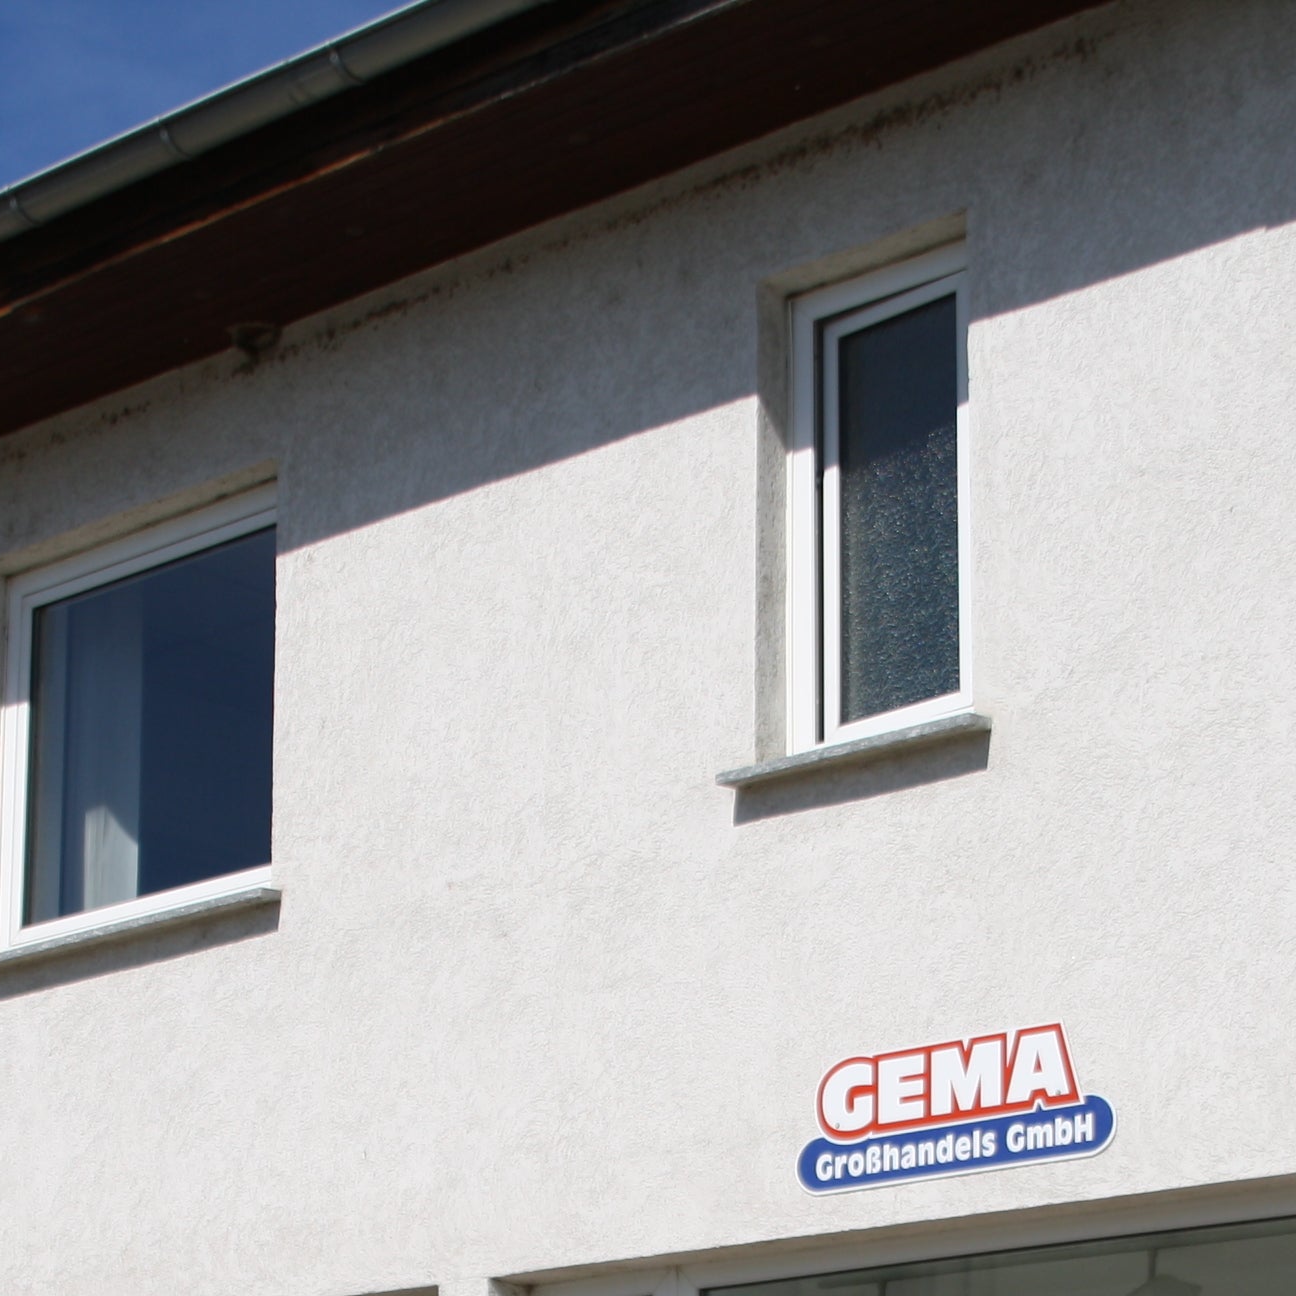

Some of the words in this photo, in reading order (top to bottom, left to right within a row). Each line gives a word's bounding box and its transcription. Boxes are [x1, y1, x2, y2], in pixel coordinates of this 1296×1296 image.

[817, 1023, 1080, 1135] GEMA
[815, 1130, 996, 1182] Großhandels
[1006, 1113, 1094, 1153] GmbH
